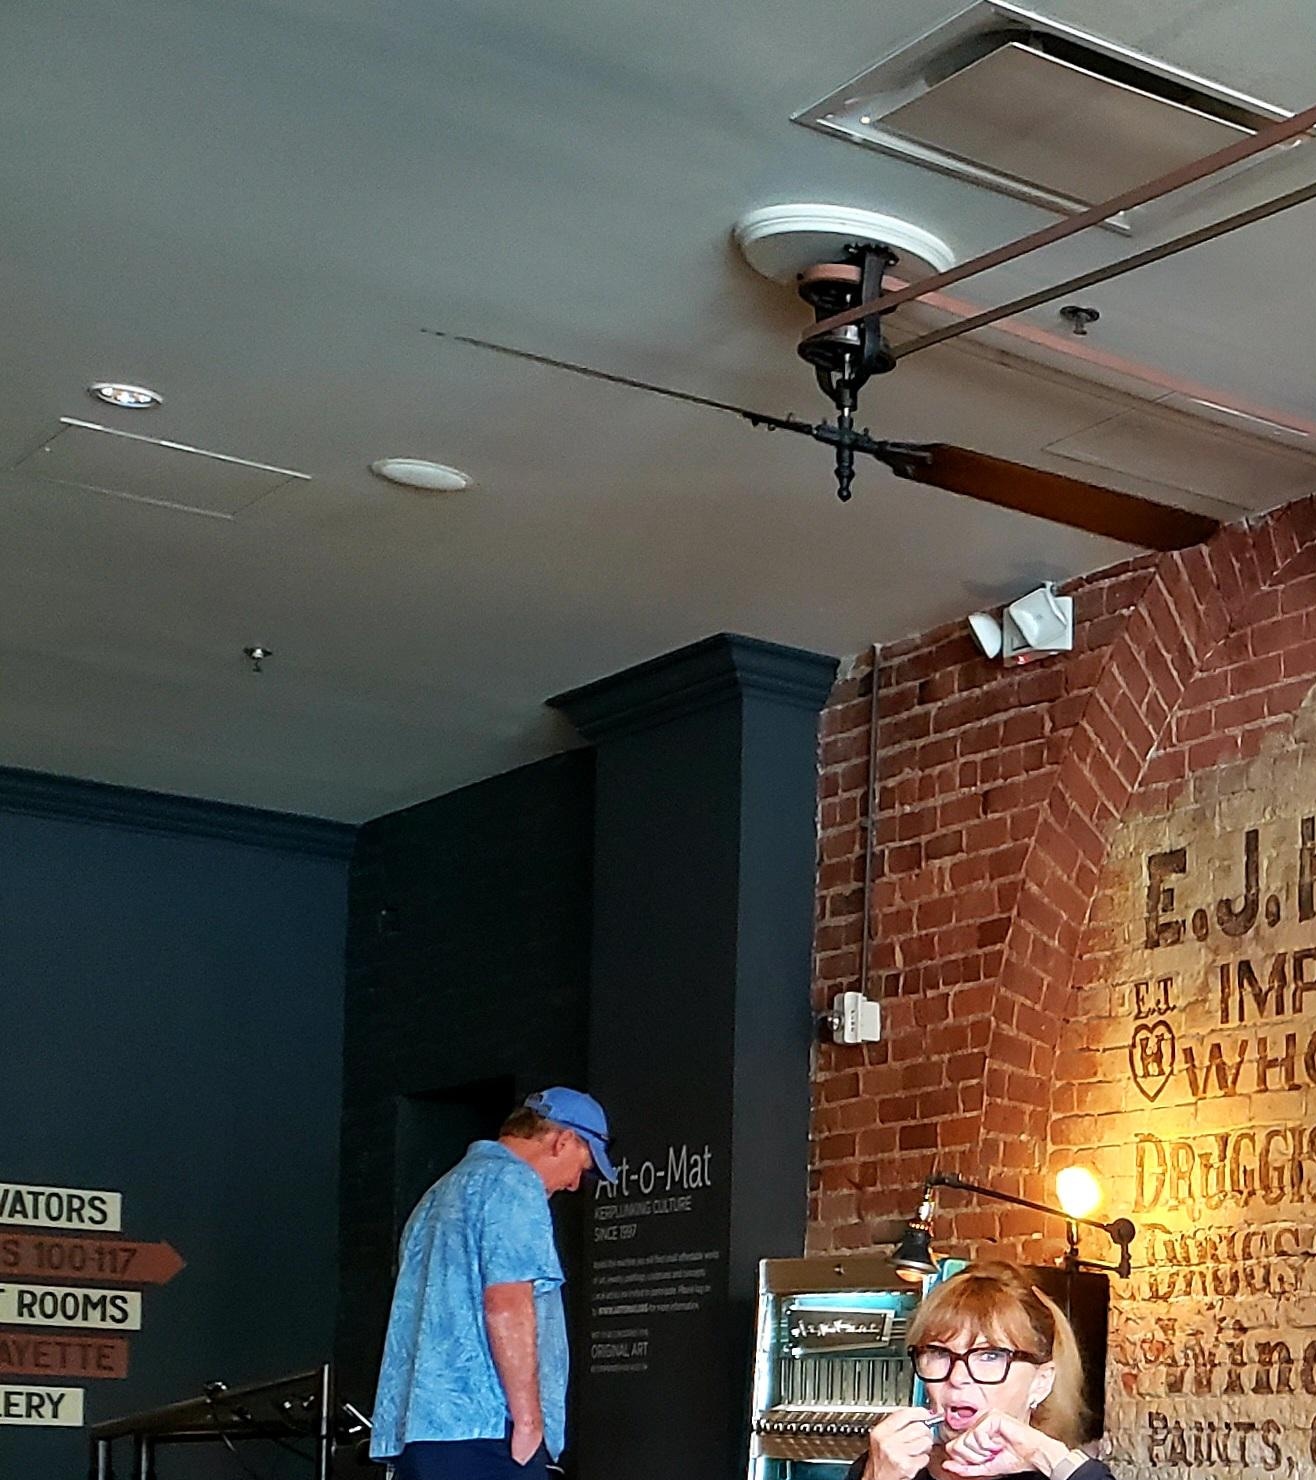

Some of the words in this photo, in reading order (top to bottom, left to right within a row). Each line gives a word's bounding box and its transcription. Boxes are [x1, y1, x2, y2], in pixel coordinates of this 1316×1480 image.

[36, 1241, 137, 1276] 100-117
[17, 1289, 129, 1324] ROOMS
[631, 1341, 648, 1356] ART
[0, 1391, 65, 1419] ERY
